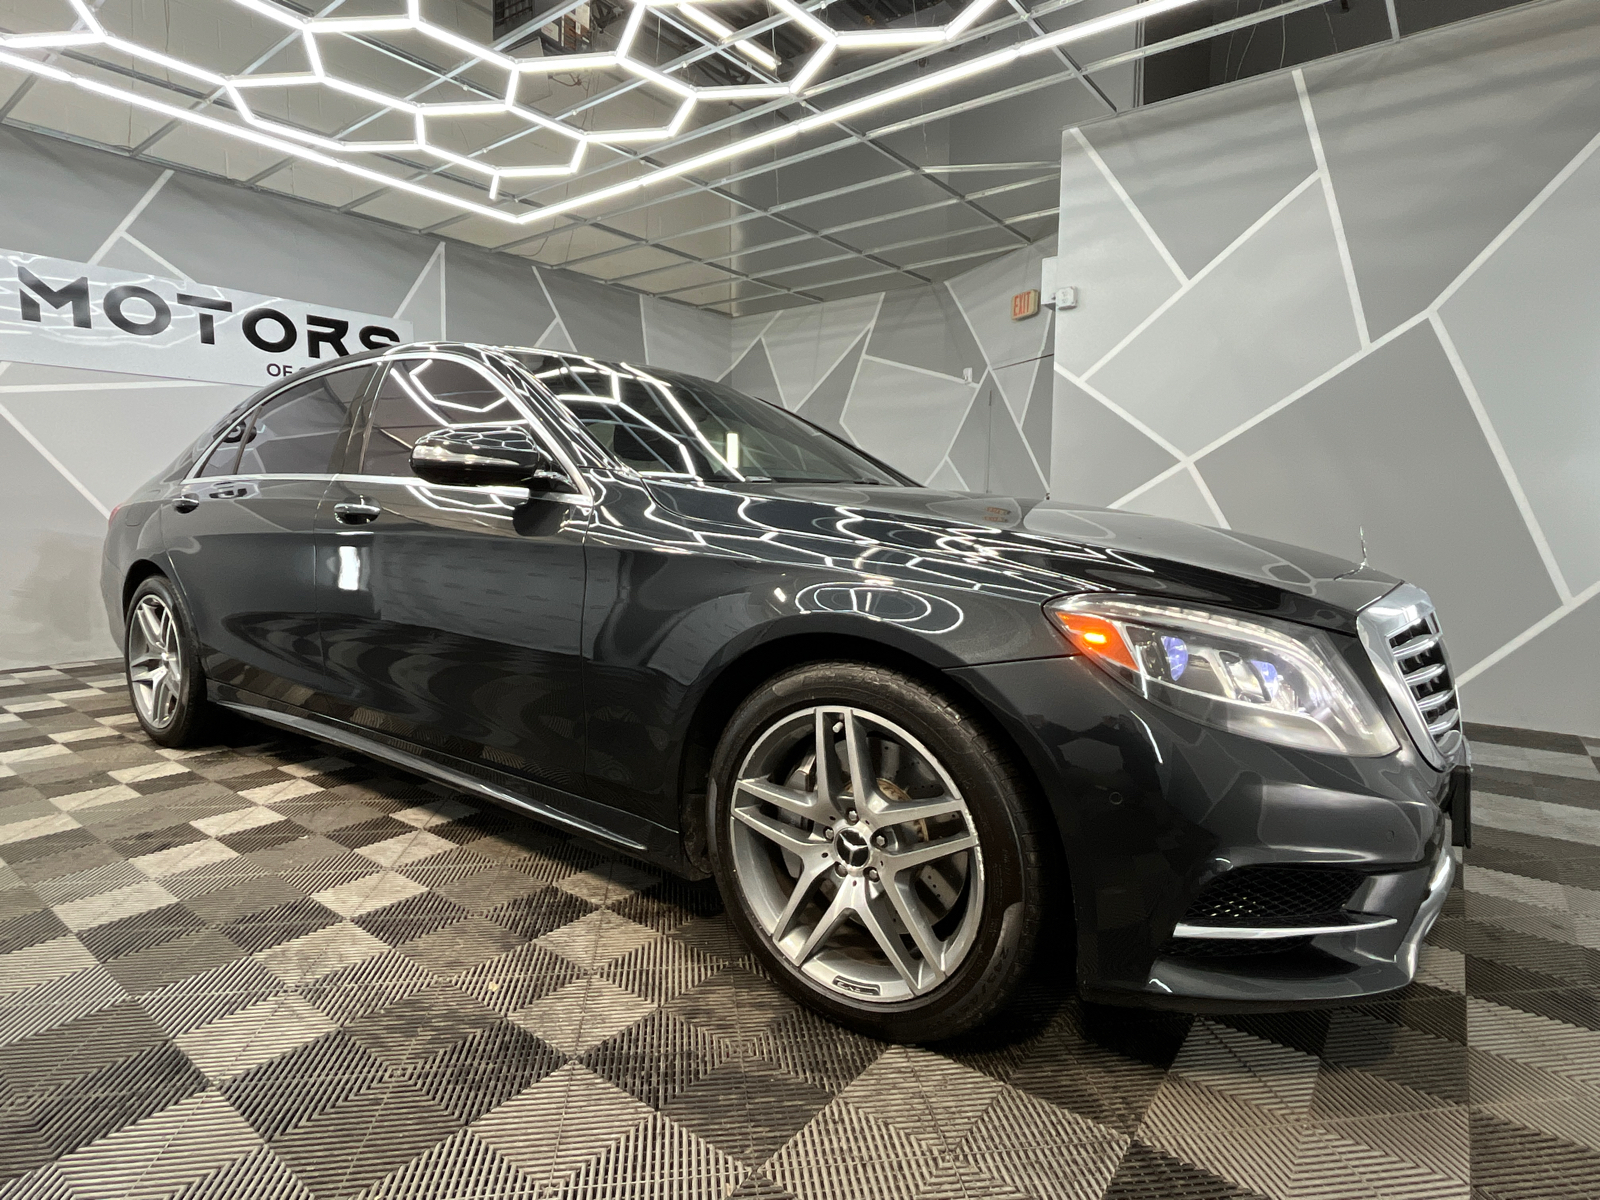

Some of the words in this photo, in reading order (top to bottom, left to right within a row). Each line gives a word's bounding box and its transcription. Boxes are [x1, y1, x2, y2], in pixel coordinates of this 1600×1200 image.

[18, 266, 400, 359] MOTORS
[1014, 292, 1031, 316] EXIT
[267, 363, 293, 377] OF
